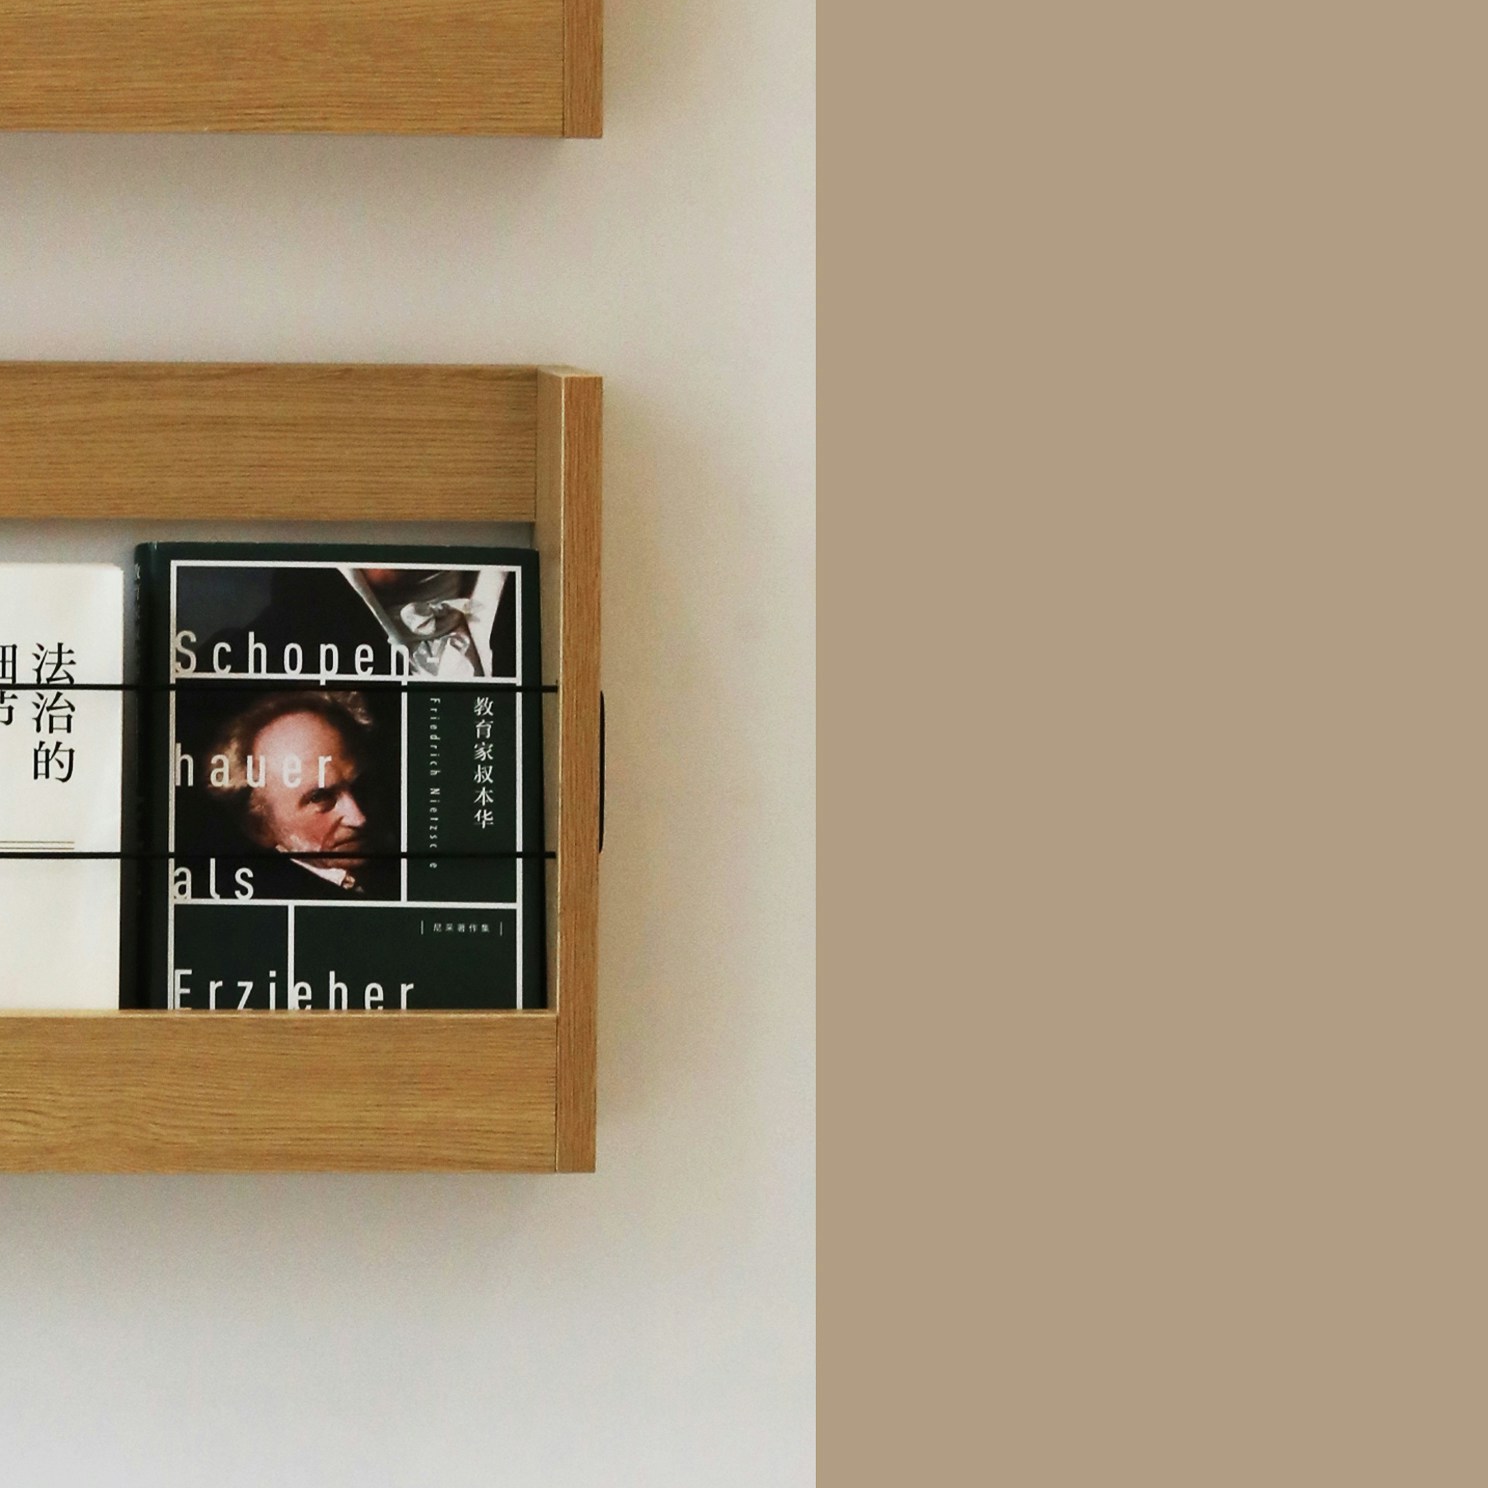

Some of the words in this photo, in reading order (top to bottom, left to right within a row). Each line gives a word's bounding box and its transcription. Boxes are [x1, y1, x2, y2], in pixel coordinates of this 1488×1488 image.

[31, 641, 78, 783] 法治的
[429, 697, 442, 776] Friedrich
[175, 742, 333, 790] hauer
[473, 695, 495, 830] 教育家叔本华
[429, 787, 442, 869] Nietzsce
[173, 858, 255, 900] als
[174, 968, 415, 1010] Erzieher
